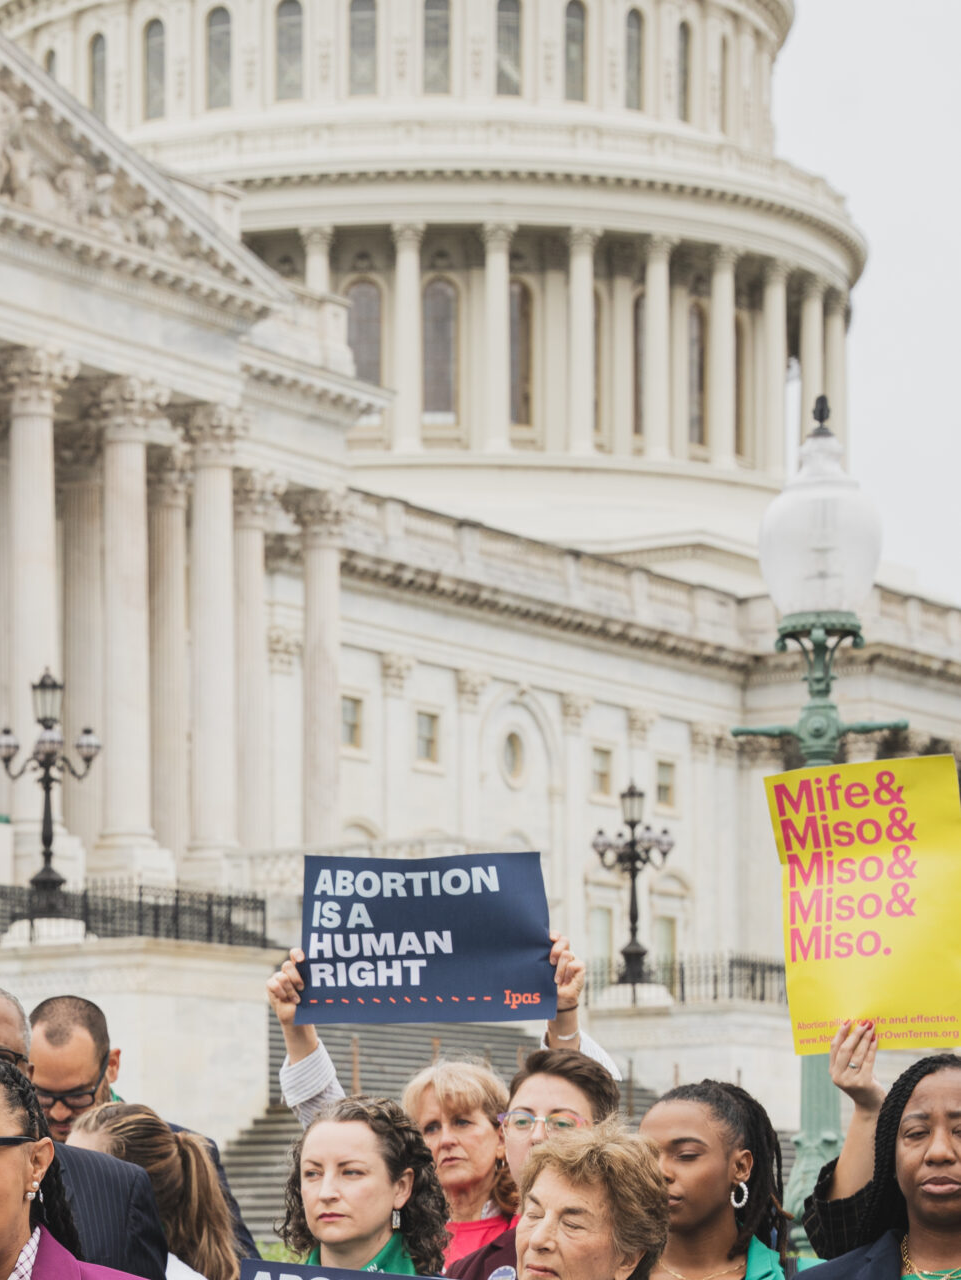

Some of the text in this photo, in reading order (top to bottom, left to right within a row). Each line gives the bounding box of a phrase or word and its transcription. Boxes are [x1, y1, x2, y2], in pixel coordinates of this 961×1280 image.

[774, 771, 906, 817] Mife&
[780, 807, 917, 852] Miso&
[314, 866, 500, 898] ABORTION
[787, 844, 917, 888] Miso&
[312, 901, 374, 928] IS A
[789, 882, 917, 925] Miso&
[309, 931, 453, 959] HUMAN
[790, 924, 892, 963] Miso.
[310, 960, 427, 987] RIGHT
[503, 990, 541, 1009] Ipas
[889, 1016, 907, 1024] and
[911, 1014, 959, 1023] effective.
